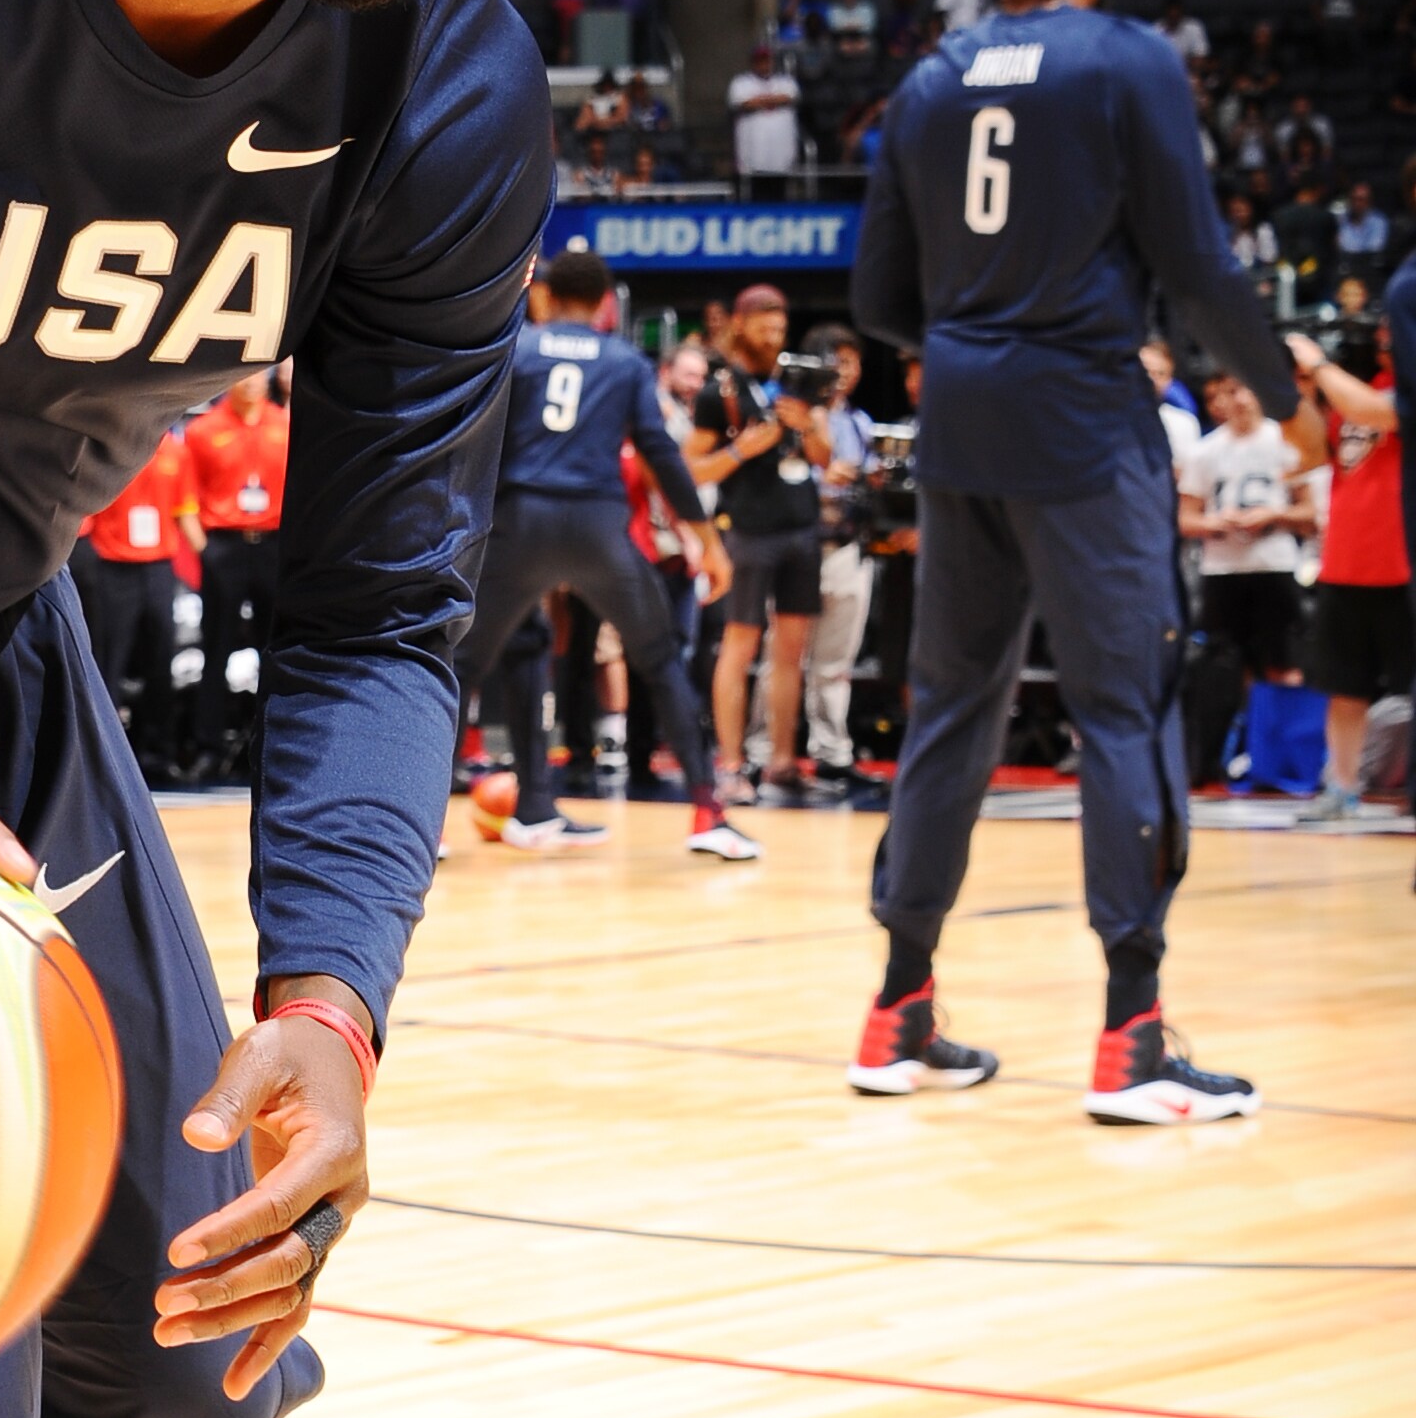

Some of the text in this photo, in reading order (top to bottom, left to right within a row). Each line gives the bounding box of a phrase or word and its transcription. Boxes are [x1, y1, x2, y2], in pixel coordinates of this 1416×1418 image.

[963, 106, 1015, 235] 6
[595, 214, 845, 258] BUD LIGHT
[541, 361, 585, 433] 9
